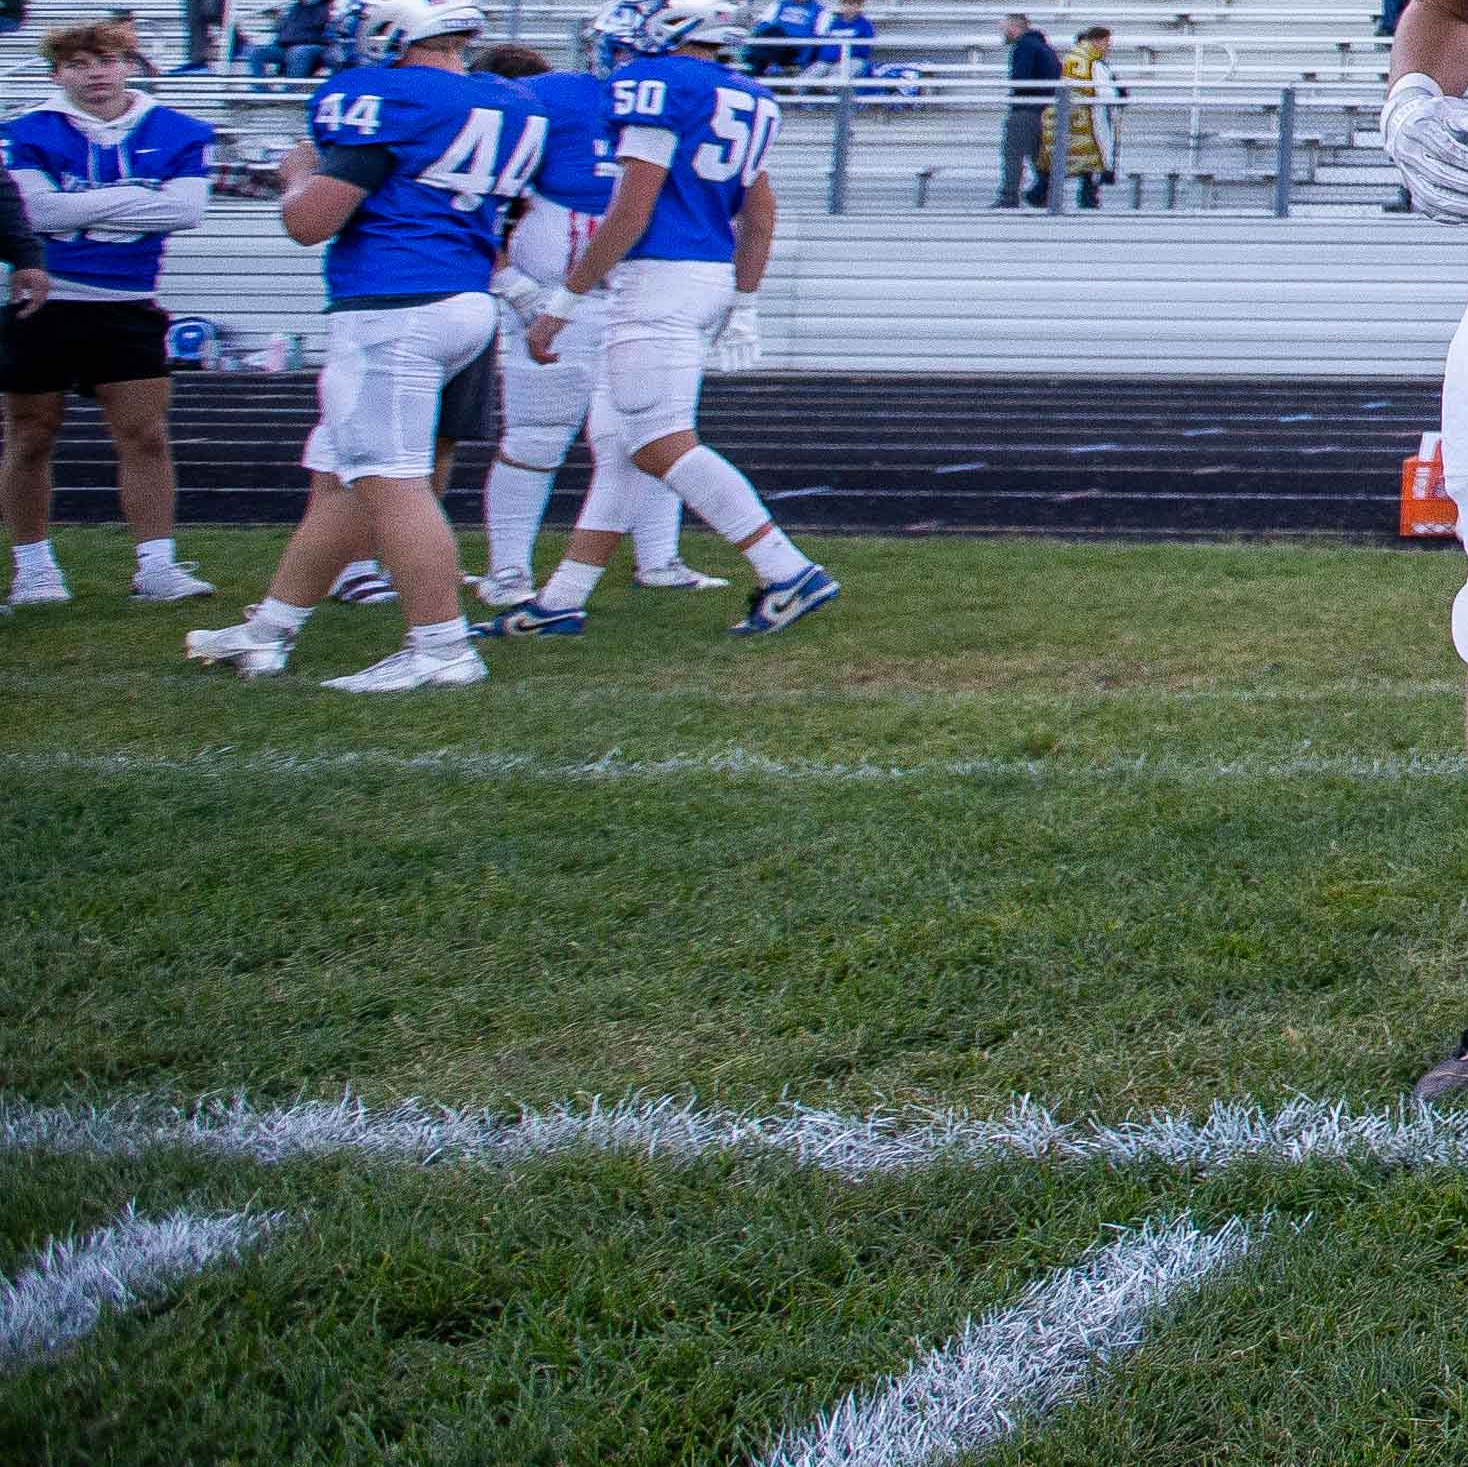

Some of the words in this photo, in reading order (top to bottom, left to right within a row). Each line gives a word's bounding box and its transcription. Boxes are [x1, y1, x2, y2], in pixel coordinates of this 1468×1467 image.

[314, 93, 384, 135] 44
[611, 80, 667, 116] 50
[416, 108, 549, 212] 44
[691, 87, 783, 188] 50
